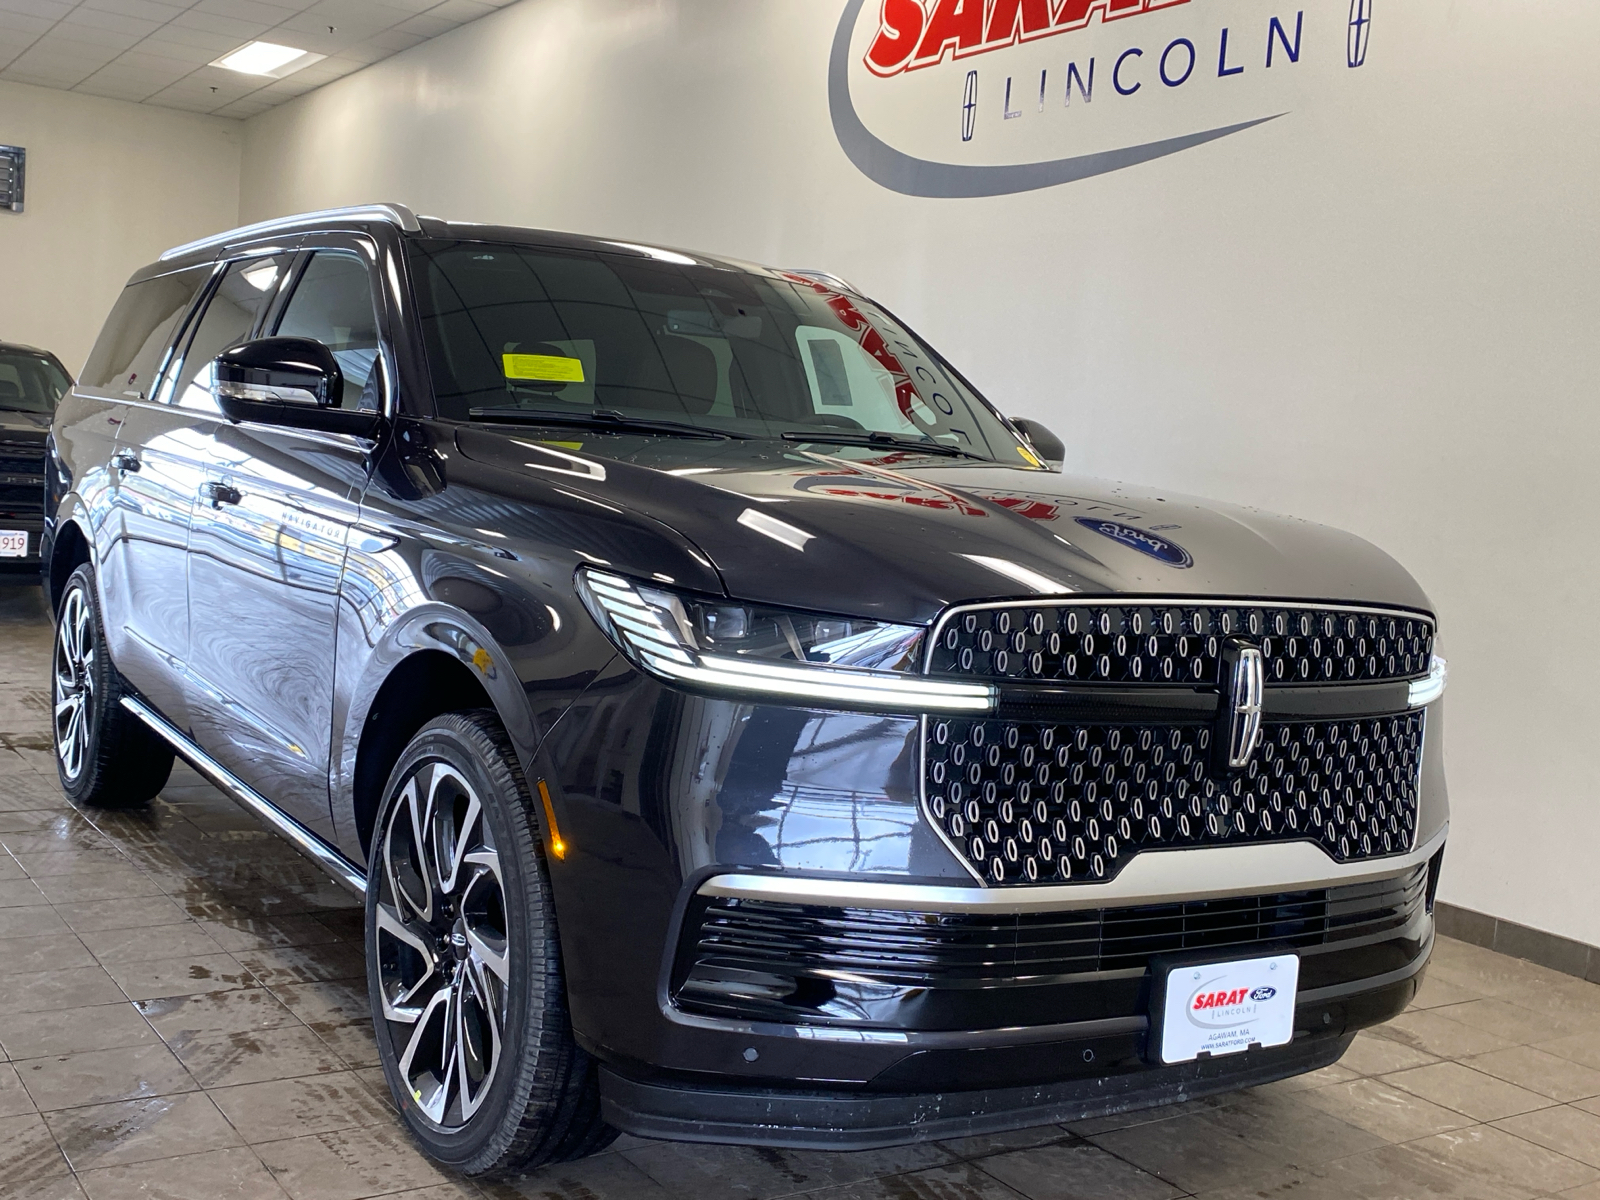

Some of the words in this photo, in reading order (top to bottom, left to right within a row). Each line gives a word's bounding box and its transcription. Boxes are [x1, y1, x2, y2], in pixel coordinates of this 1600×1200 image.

[1003, 11, 1303, 120] LINCOLN
[281, 512, 341, 538] NAVIGATOR
[2, 537, 25, 550] 919
[1193, 988, 1249, 1010] SARAT
[1252, 987, 1274, 1000] Ford
[1217, 1006, 1251, 1017] LINCOLN
[1240, 1028, 1250, 1036] MA
[1201, 1037, 1256, 1050] WWW.SARATFORD.COM
